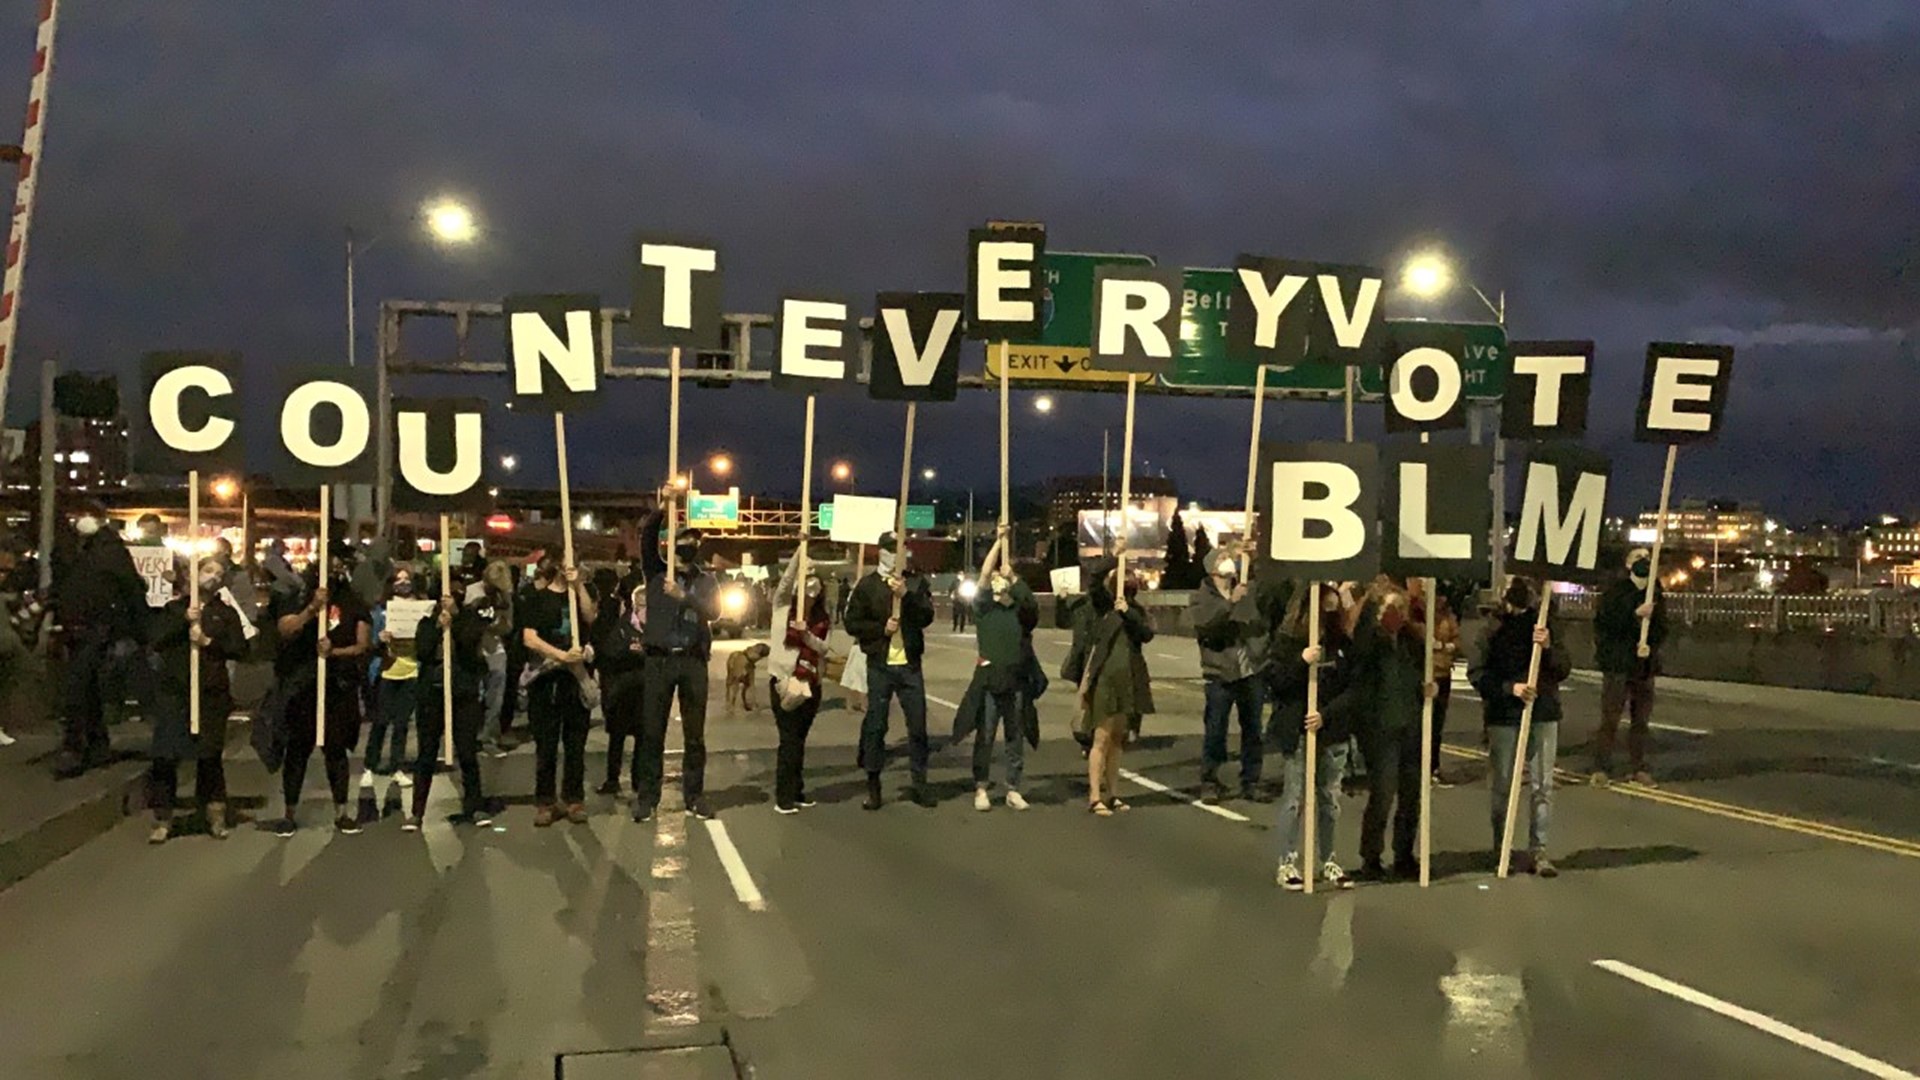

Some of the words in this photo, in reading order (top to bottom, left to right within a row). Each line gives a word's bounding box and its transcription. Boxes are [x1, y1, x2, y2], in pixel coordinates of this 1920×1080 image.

[1183, 289, 1231, 309] Bel
[1008, 354, 1049, 369] EXIT
[135, 556, 170, 574] VERY
